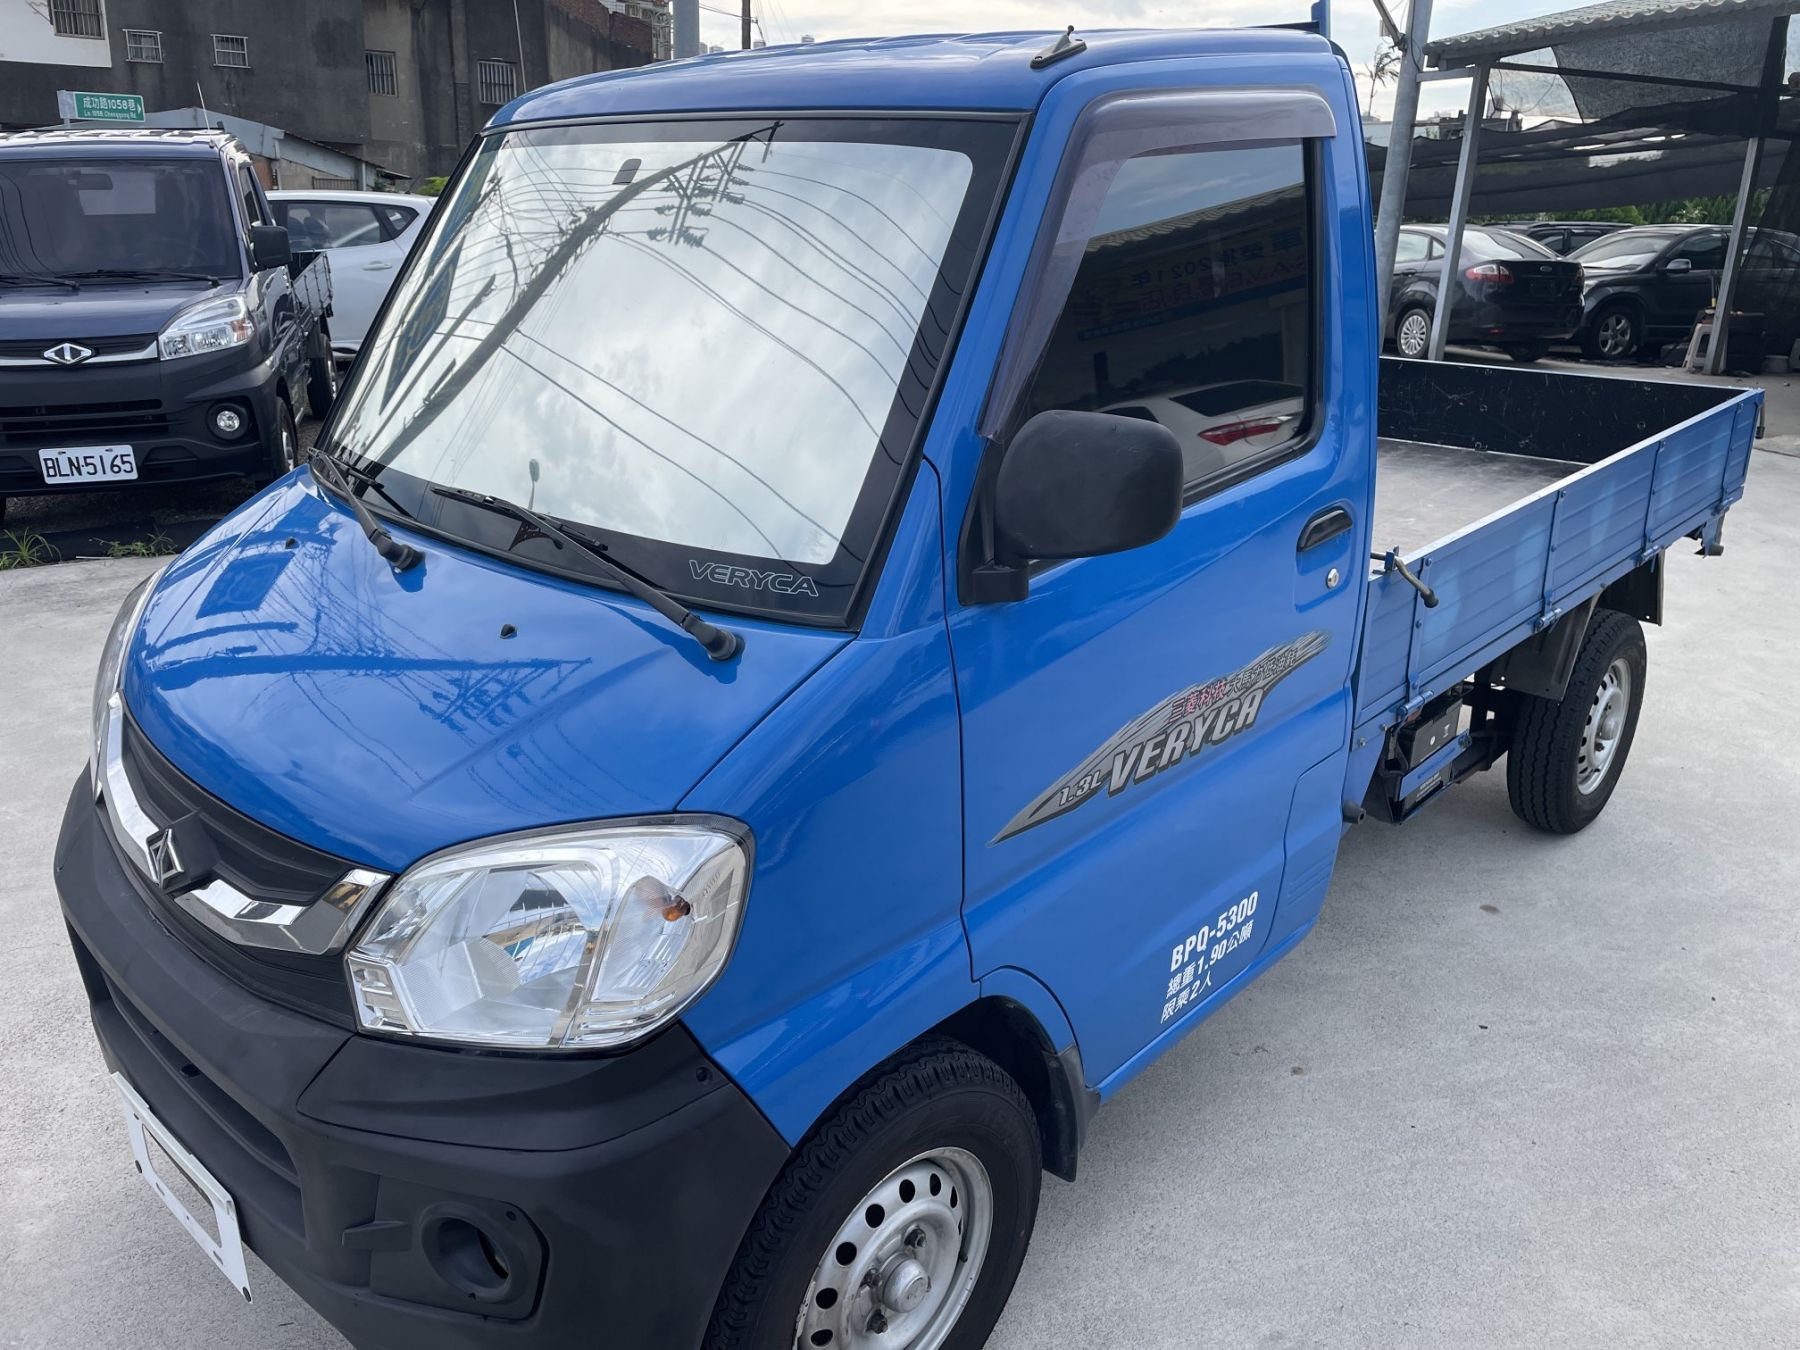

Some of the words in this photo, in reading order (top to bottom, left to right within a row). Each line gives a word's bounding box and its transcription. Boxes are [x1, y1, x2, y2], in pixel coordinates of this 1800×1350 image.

[83, 96, 136, 111] 成功路1058巷
[689, 559, 819, 597] VERYCA
[1058, 769, 1102, 807] 1.3L
[1170, 891, 1259, 973] BPQ-5300
